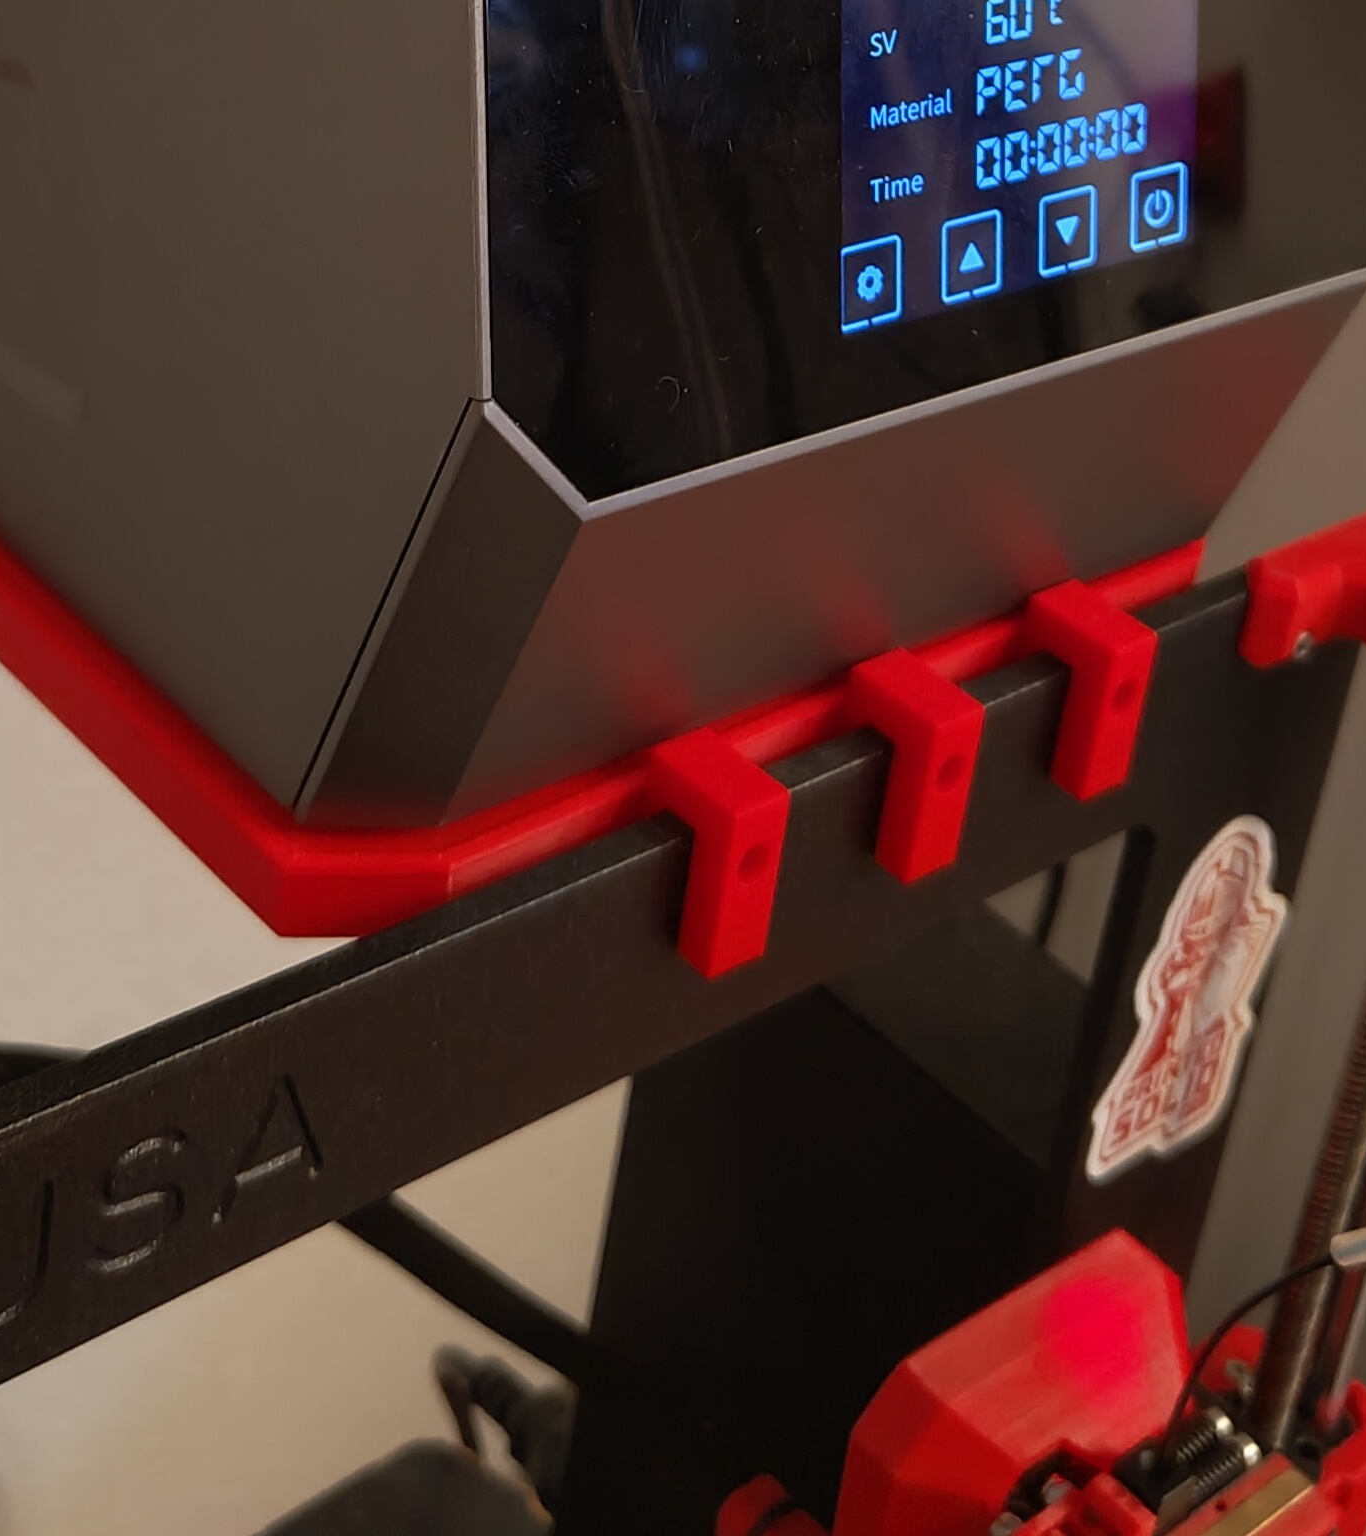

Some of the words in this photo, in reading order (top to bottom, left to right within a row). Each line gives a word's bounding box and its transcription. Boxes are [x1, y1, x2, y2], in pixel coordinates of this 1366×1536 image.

[870, 28, 897, 57] SV
[869, 87, 953, 130] Material
[869, 173, 925, 203] Time
[976, 102, 1147, 190] 00:00:00
